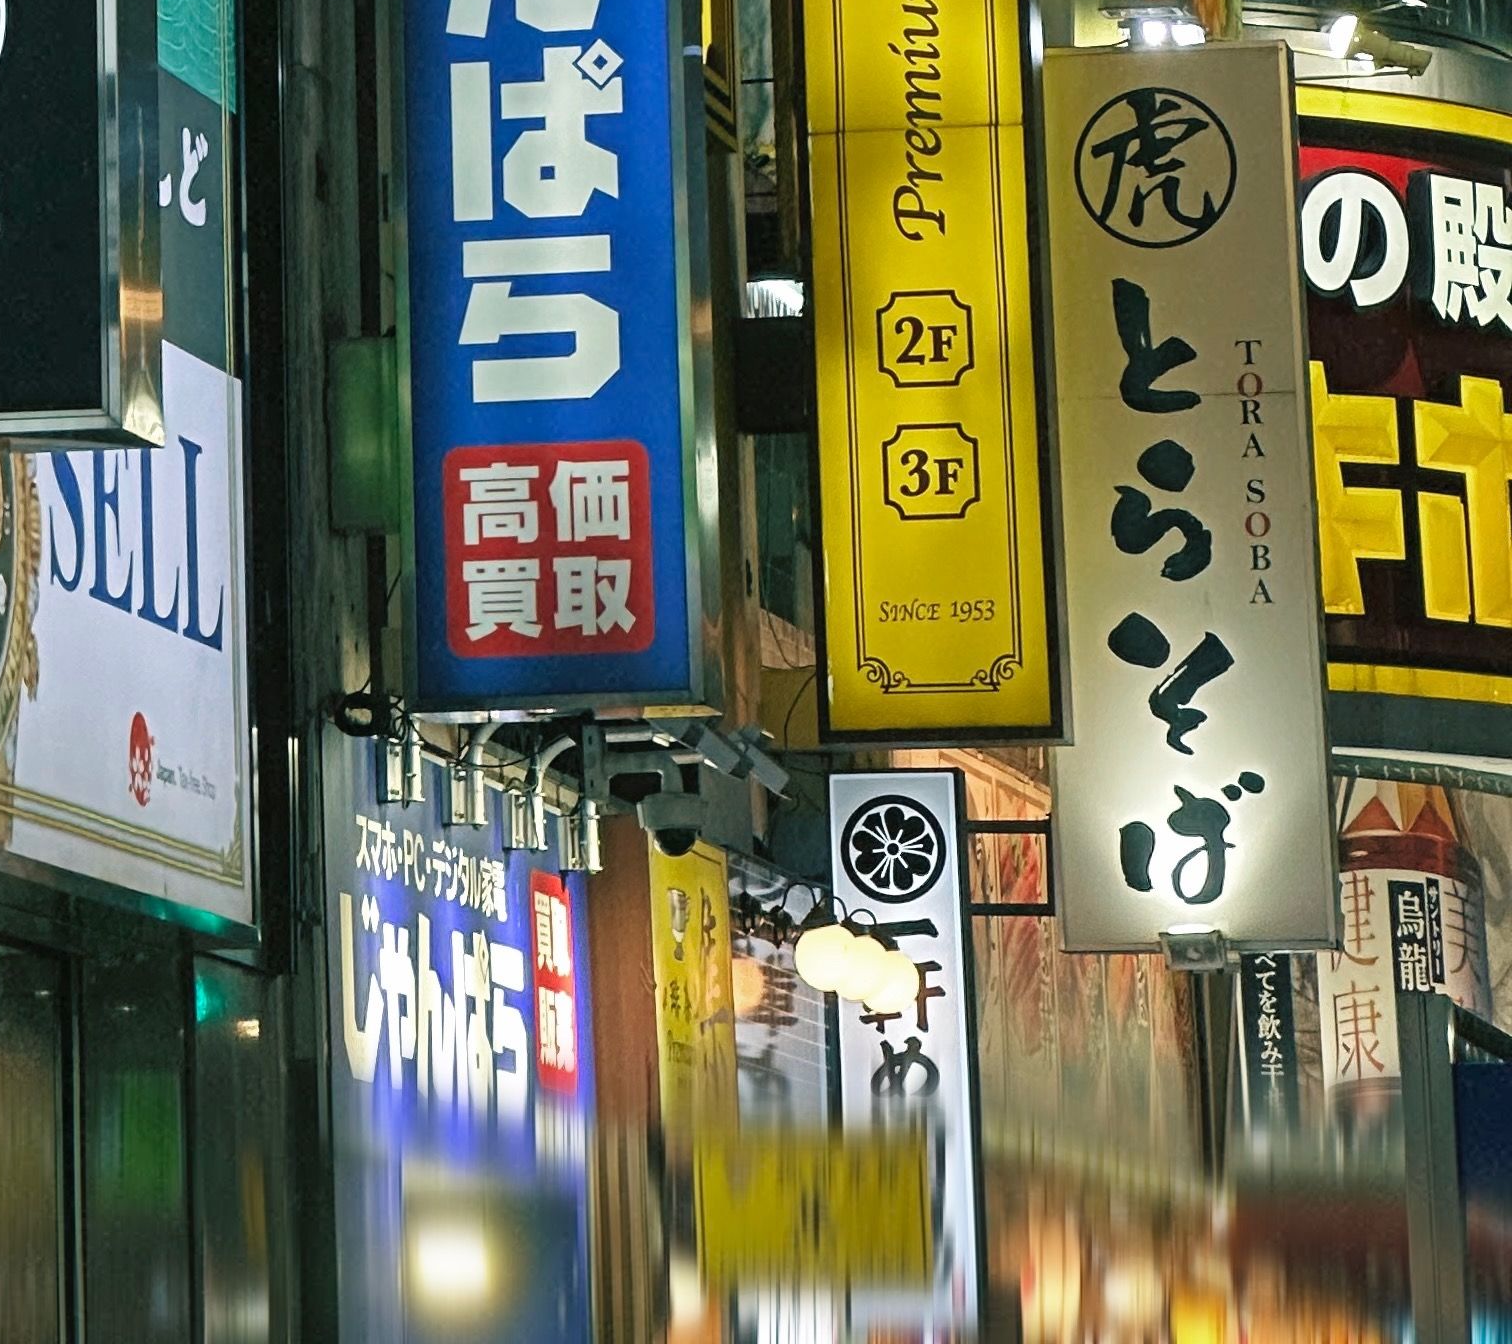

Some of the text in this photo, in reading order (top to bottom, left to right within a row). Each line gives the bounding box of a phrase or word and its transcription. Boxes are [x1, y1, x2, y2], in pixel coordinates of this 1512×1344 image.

[893, 314, 959, 368] 2F
[49, 434, 224, 653] SELL
[898, 448, 965, 498] 3F
[1234, 338, 1276, 606] TORA SOBA
[949, 598, 996, 624] 1953
[1107, 276, 1266, 905] とらそば
[339, 891, 529, 1114] じゃんぱら
